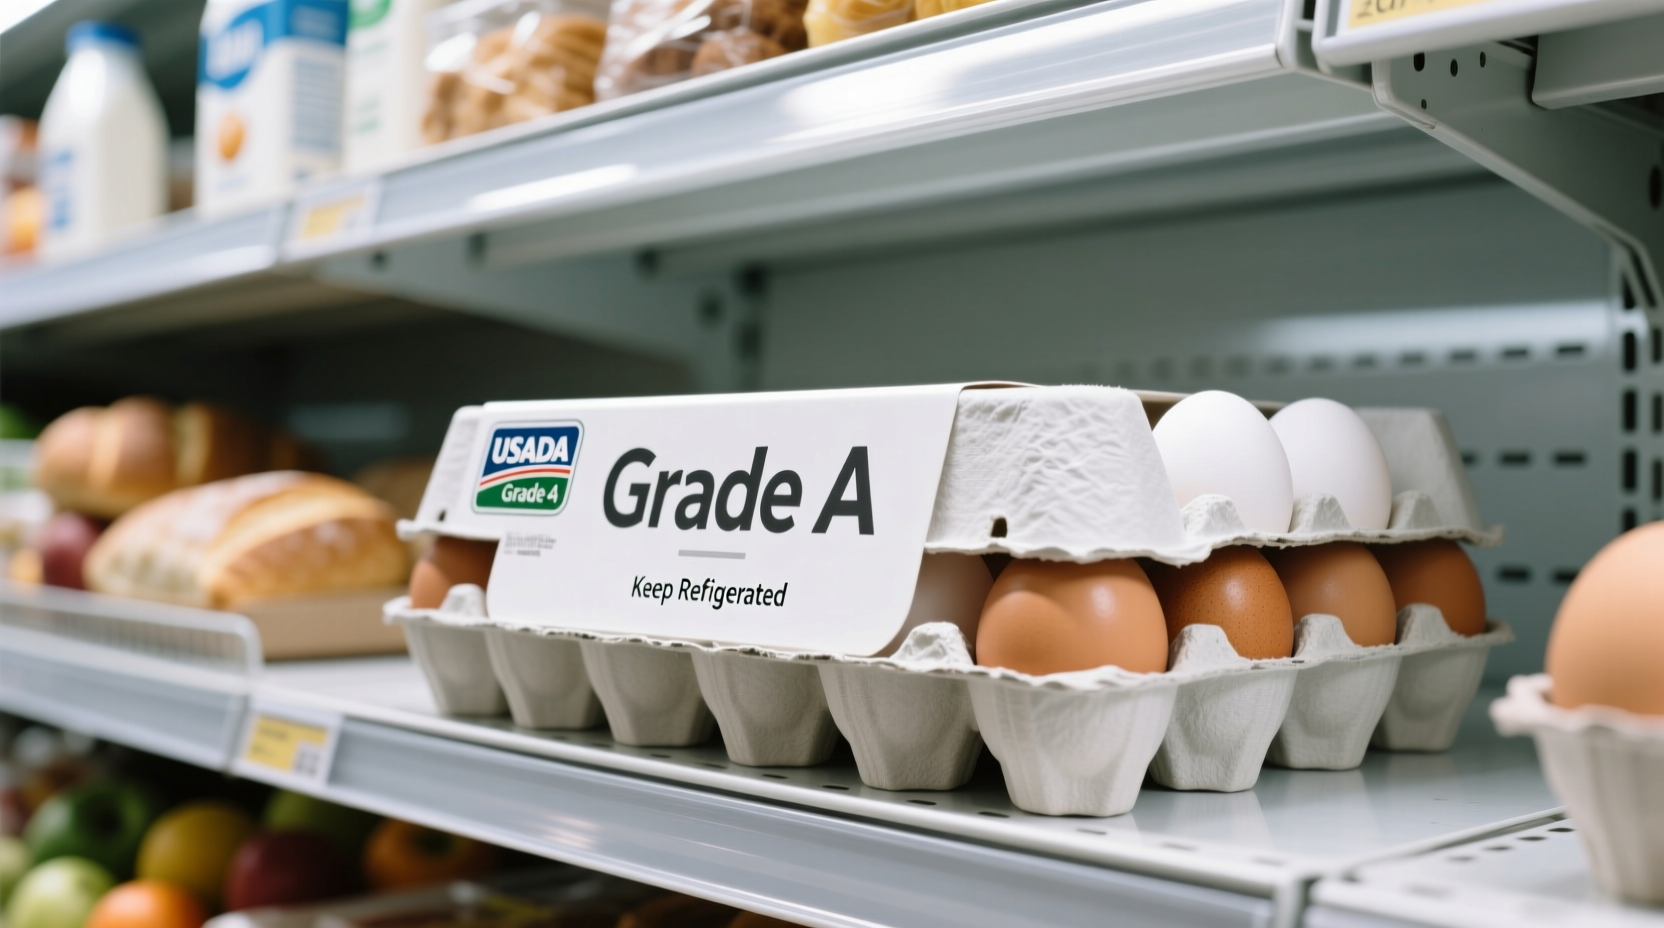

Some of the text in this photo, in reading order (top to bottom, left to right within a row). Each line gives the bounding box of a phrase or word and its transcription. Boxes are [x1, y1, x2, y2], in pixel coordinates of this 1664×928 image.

[491, 435, 569, 465] USADA
[501, 482, 559, 504] Grade 4
[602, 445, 875, 536] Grade A
[631, 575, 789, 611] Keep Refigerated
